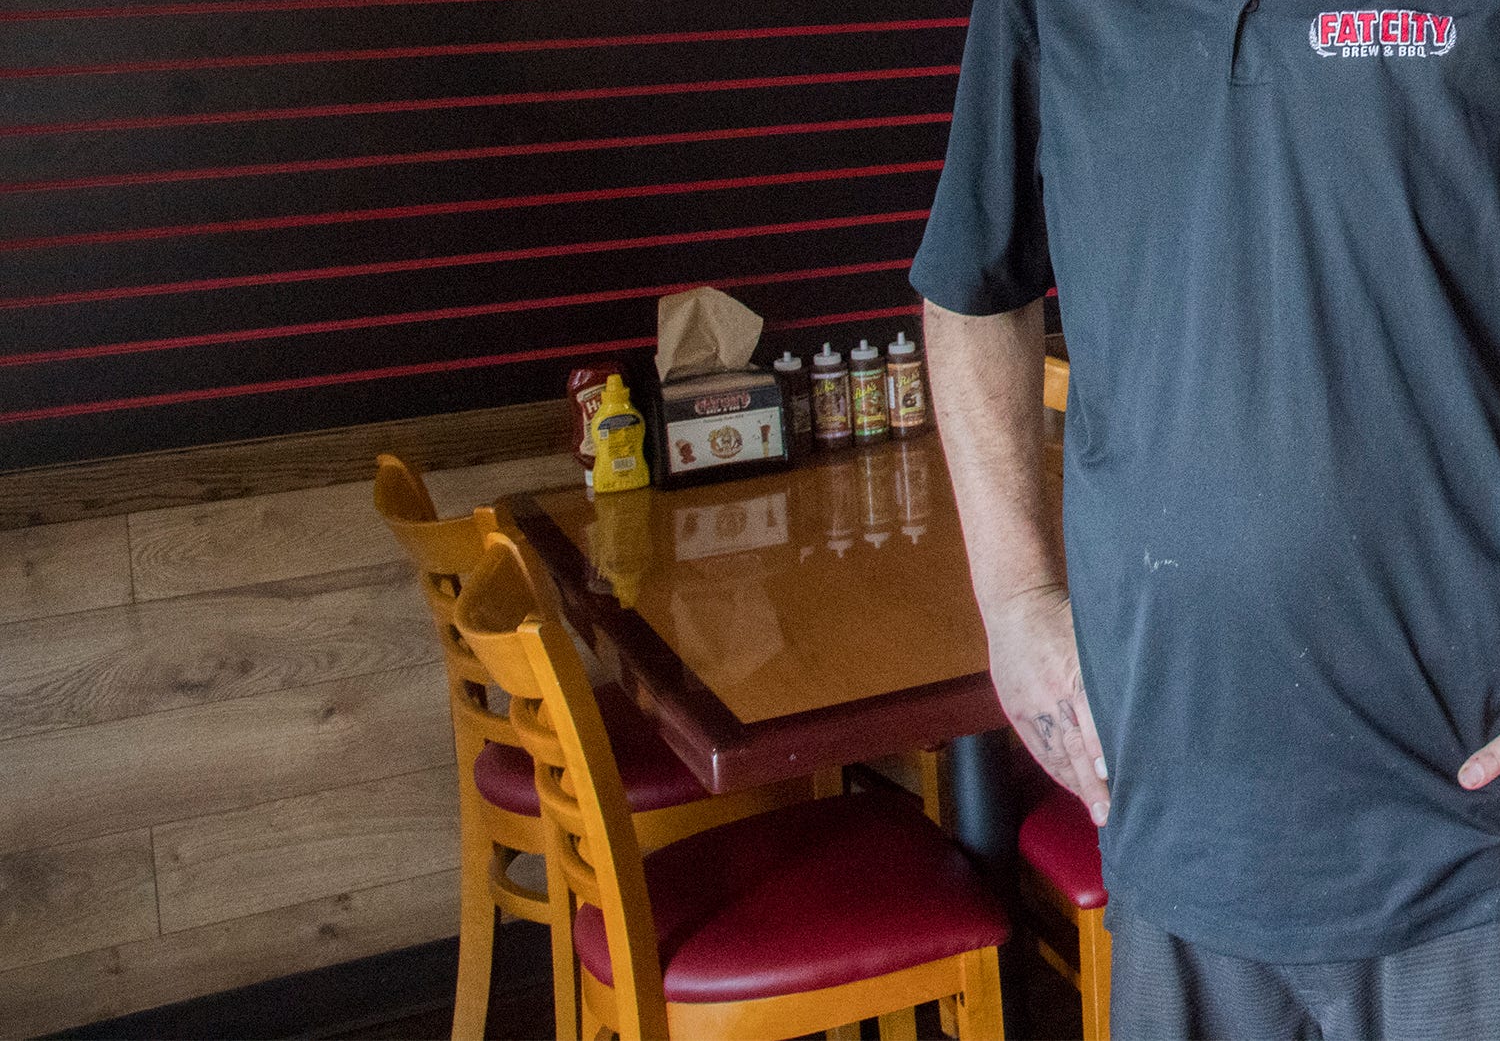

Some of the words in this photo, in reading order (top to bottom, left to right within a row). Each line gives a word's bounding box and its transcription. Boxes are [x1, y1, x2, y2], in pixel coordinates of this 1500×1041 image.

[1318, 10, 1379, 47] FAT
[1379, 9, 1453, 46] CITY
[1342, 46, 1380, 58] BREW
[1383, 46, 1394, 57] &
[1398, 46, 1427, 58] BBQ
